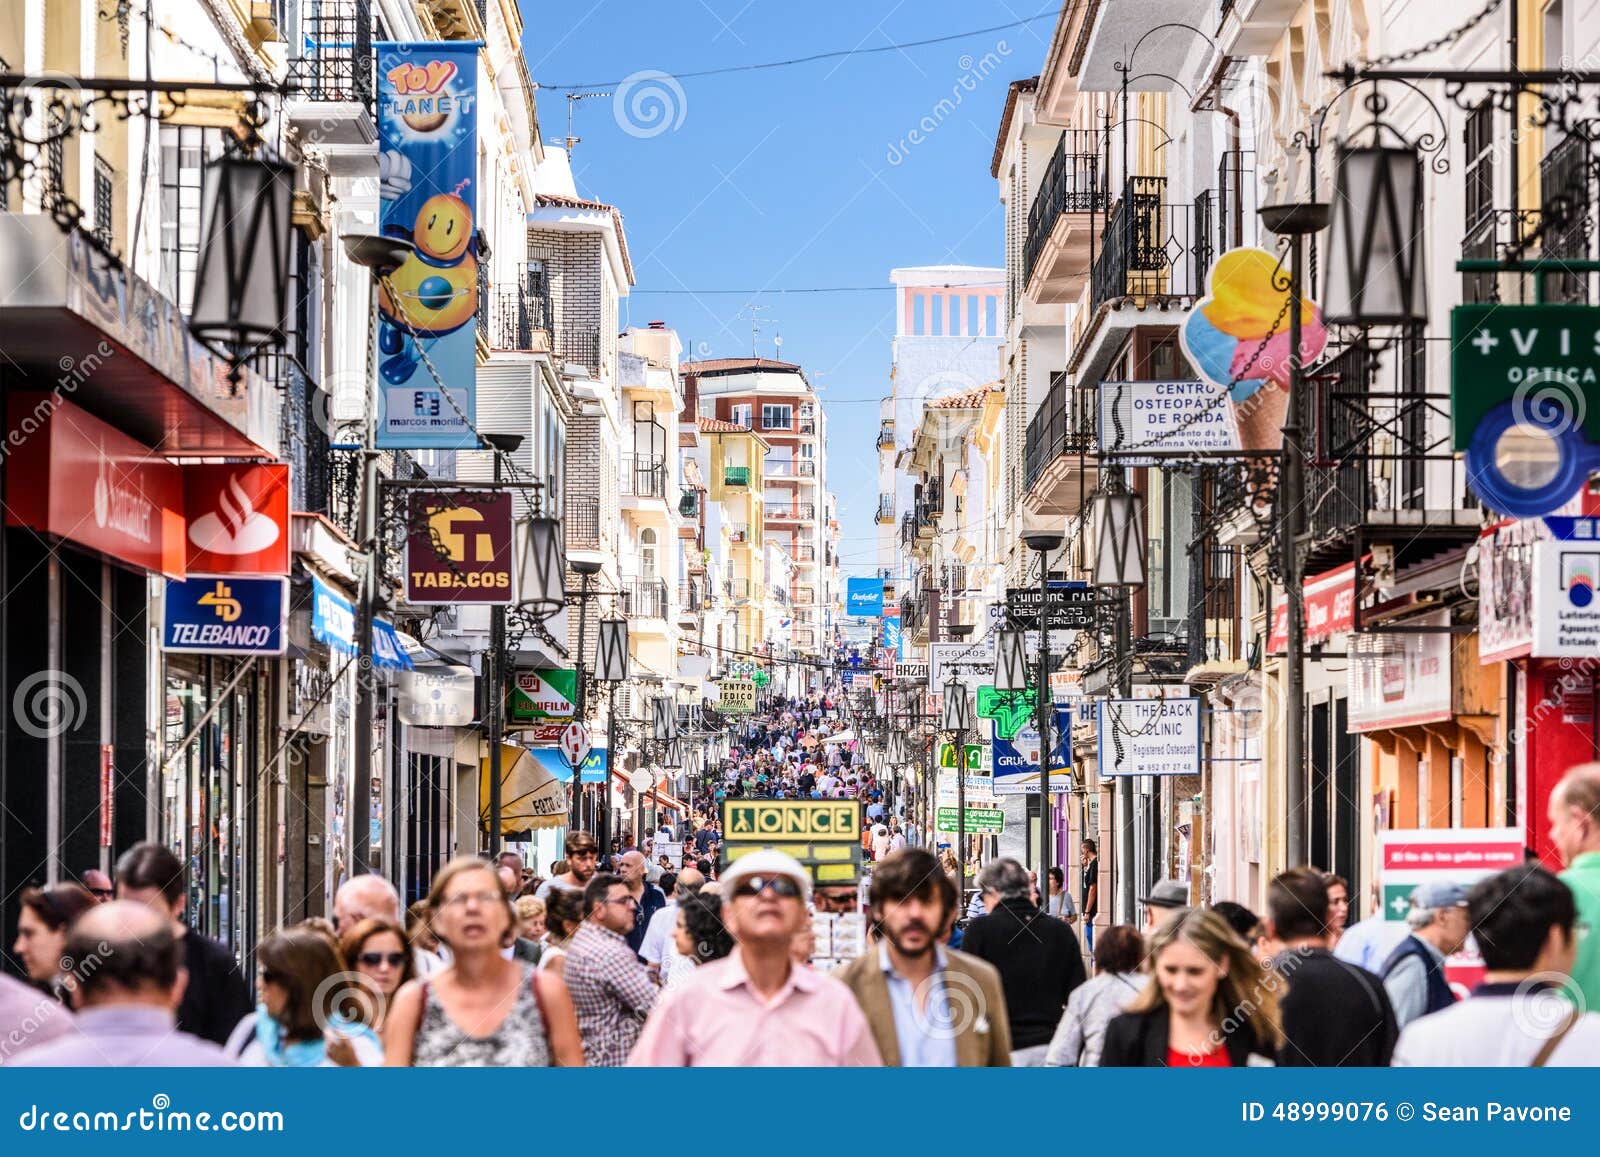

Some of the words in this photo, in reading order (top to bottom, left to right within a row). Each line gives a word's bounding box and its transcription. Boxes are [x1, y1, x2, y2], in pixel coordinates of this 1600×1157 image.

[387, 60, 458, 95] TOY
[383, 95, 475, 117] PLANET
[1134, 396, 1226, 409] OSTEOPÁTIC
[390, 418, 427, 426] marcos
[1148, 413, 1167, 424] DE
[1173, 412, 1224, 423] RONDA
[412, 571, 509, 588] TABACOS
[172, 624, 270, 646] TELEBANCO
[518, 701, 570, 711] FUJIFILM
[1135, 704, 1156, 717] THE
[1161, 703, 1193, 717] BACK
[1146, 723, 1183, 736] CLINIC
[532, 796, 555, 814] FOTO
[758, 808, 852, 833] ONCE
